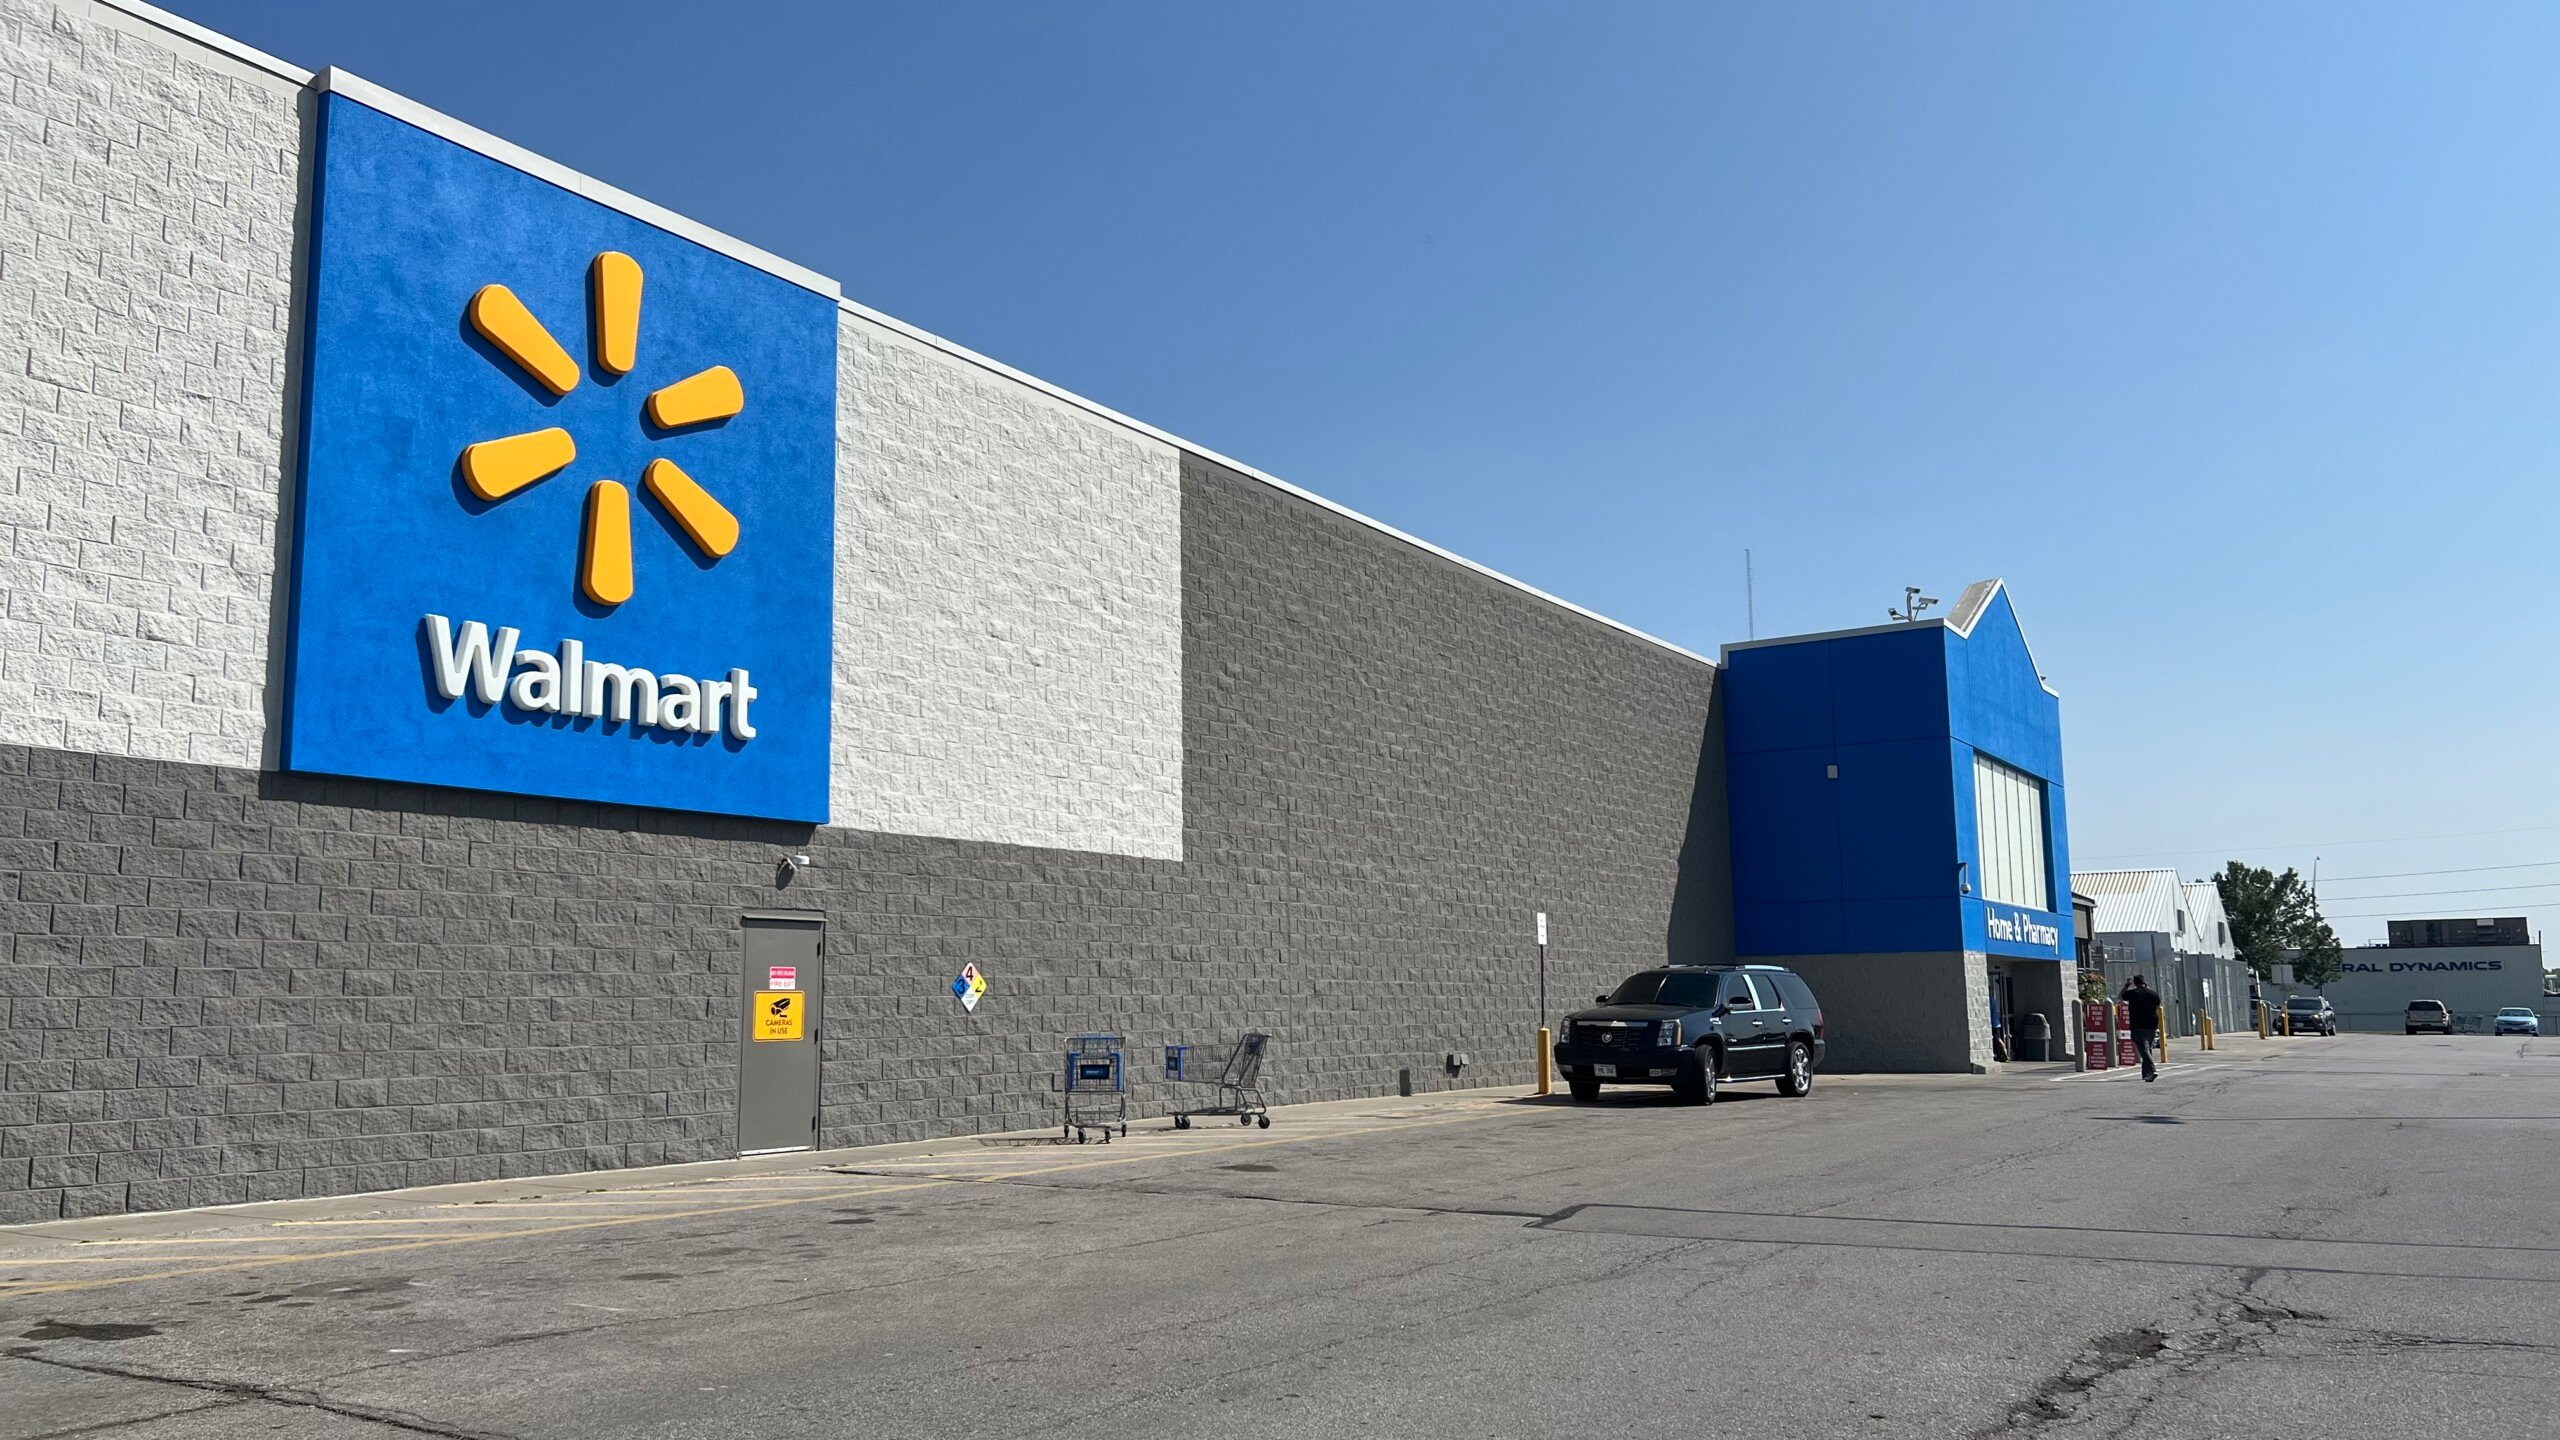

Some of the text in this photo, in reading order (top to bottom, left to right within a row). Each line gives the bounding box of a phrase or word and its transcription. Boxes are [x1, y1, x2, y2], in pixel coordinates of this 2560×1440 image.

[425, 613, 757, 740] Walmart
[1986, 907, 2058, 955] Home & Pharmacy
[966, 966, 973, 981] 4
[2331, 961, 2502, 972] ERAL DYNAMICS
[957, 979, 965, 994] 3
